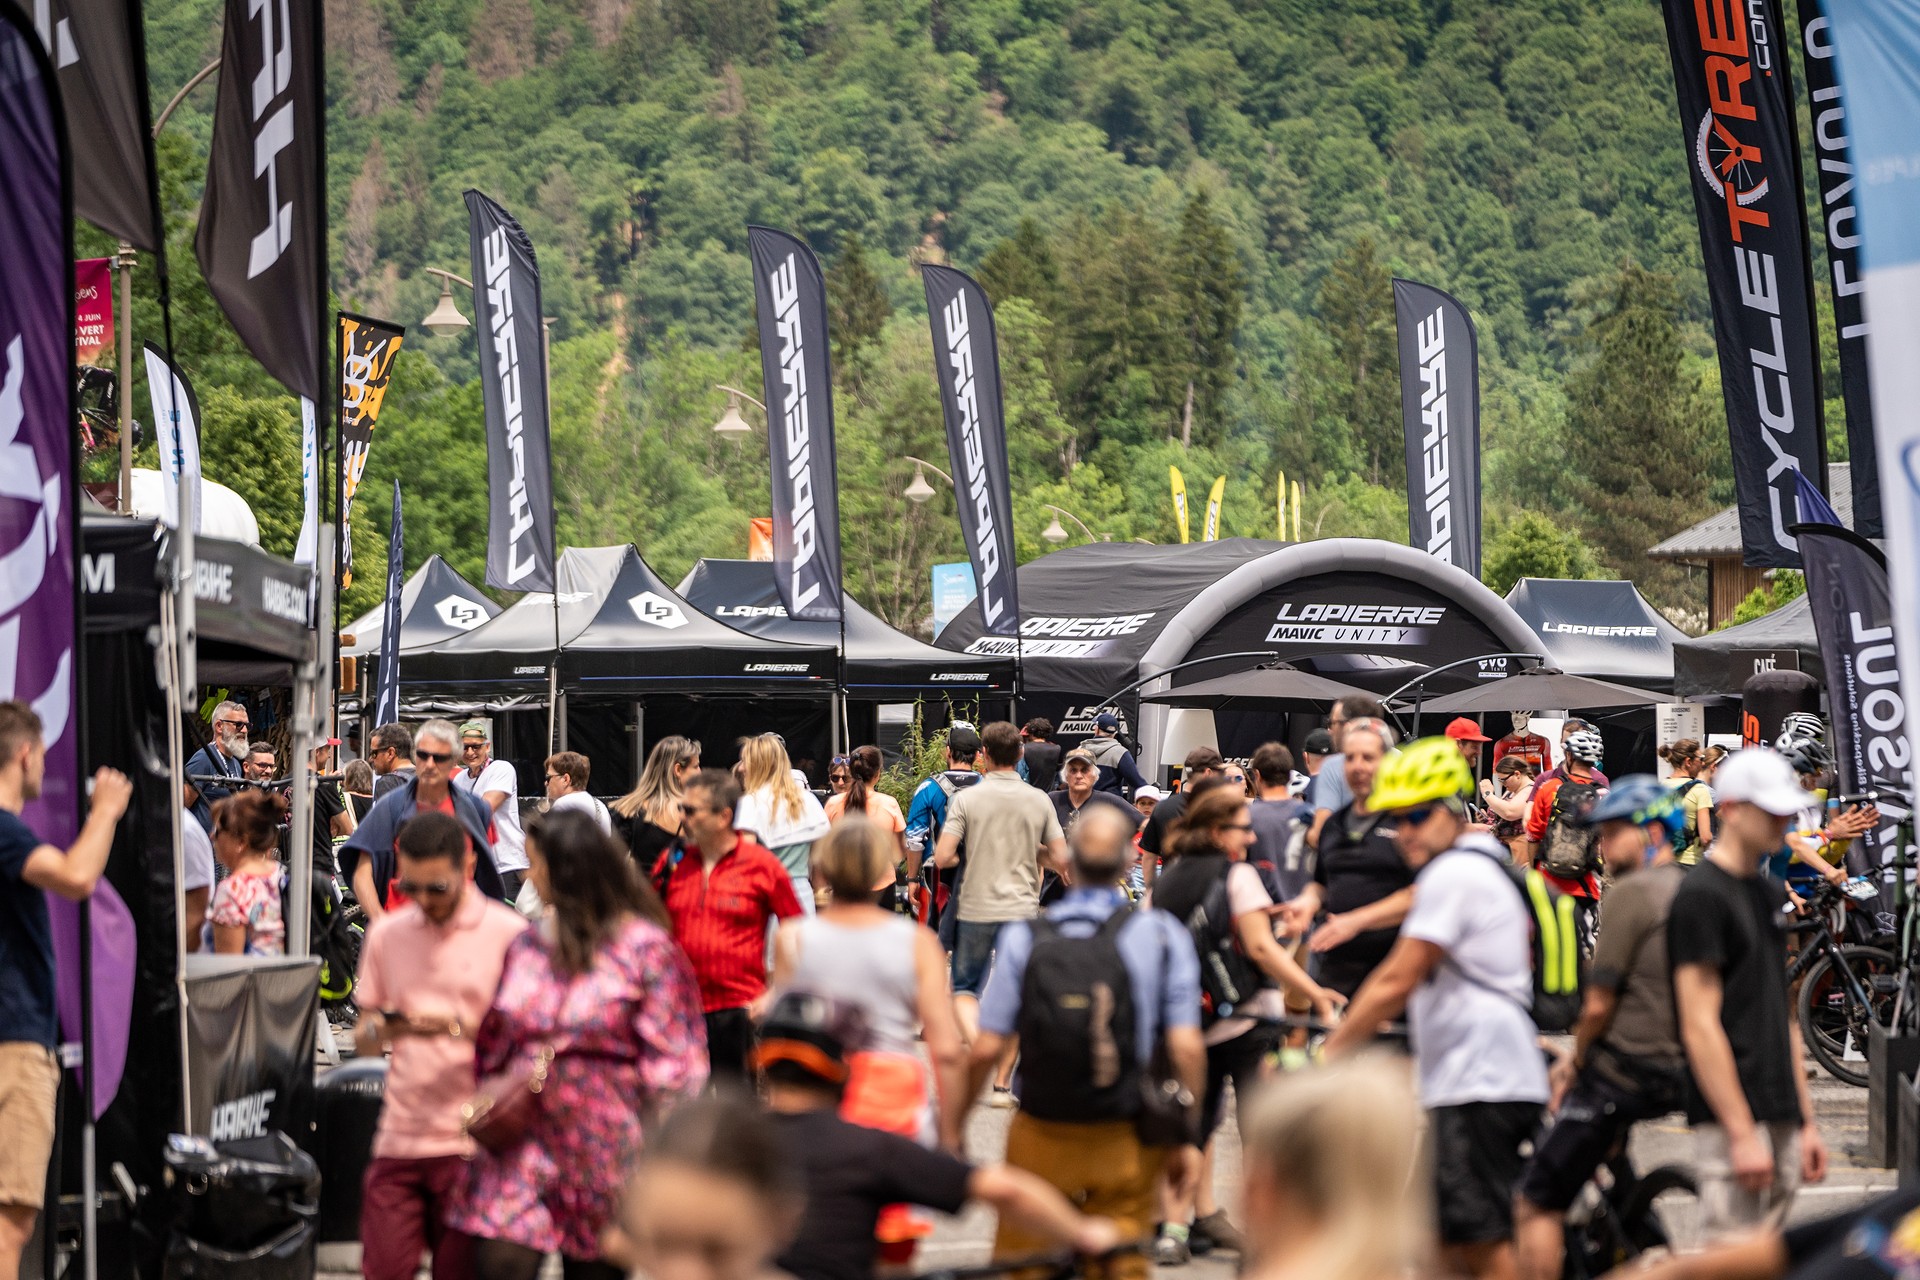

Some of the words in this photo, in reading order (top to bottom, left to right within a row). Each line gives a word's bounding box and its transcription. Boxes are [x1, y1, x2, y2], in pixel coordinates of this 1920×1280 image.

[80, 324, 105, 336] VERT
[483, 225, 536, 585] LAPIERRE
[1733, 245, 1801, 553] CYCLE
[770, 252, 821, 614] LAPIERRE
[1416, 305, 1452, 564] PIERRE
[943, 287, 1004, 628] LAPIERRE
[1018, 612, 1156, 638] APIERRE
[1276, 603, 1447, 625] LAPIERRE
[1272, 627, 1325, 640] MAVIC
[1334, 628, 1408, 642] UNITY
[1542, 621, 1657, 637] LAPIERRE
[513, 665, 546, 674] LAPIERRE
[743, 663, 810, 672] LAPIERRE
[1753, 653, 1777, 675] CAFÉ
[929, 673, 990, 681] LAPIERRE
